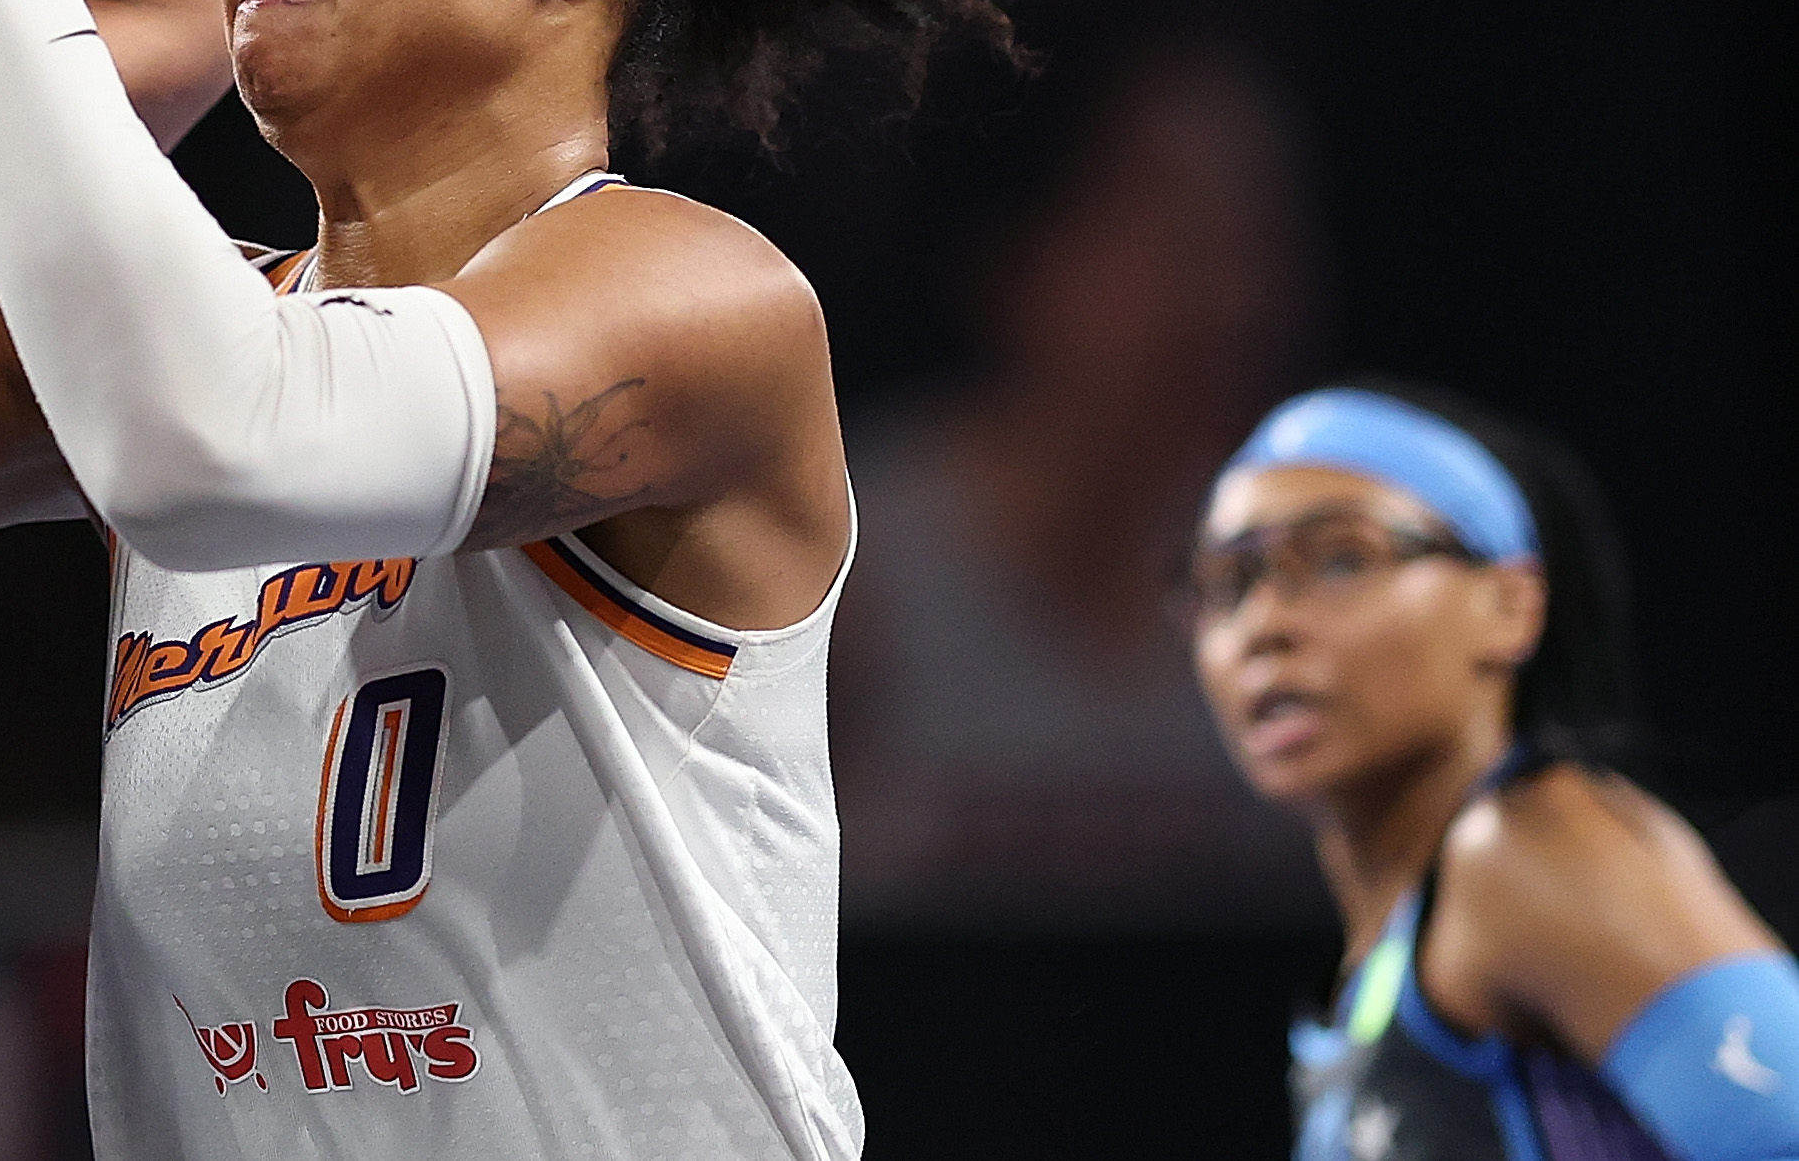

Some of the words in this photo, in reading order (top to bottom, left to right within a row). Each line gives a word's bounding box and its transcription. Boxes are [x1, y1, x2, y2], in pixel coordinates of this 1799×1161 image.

[315, 665, 451, 923] 0
[272, 979, 480, 1093] fry's
[313, 1013, 369, 1034] FOOD
[374, 1007, 449, 1029] STORES
